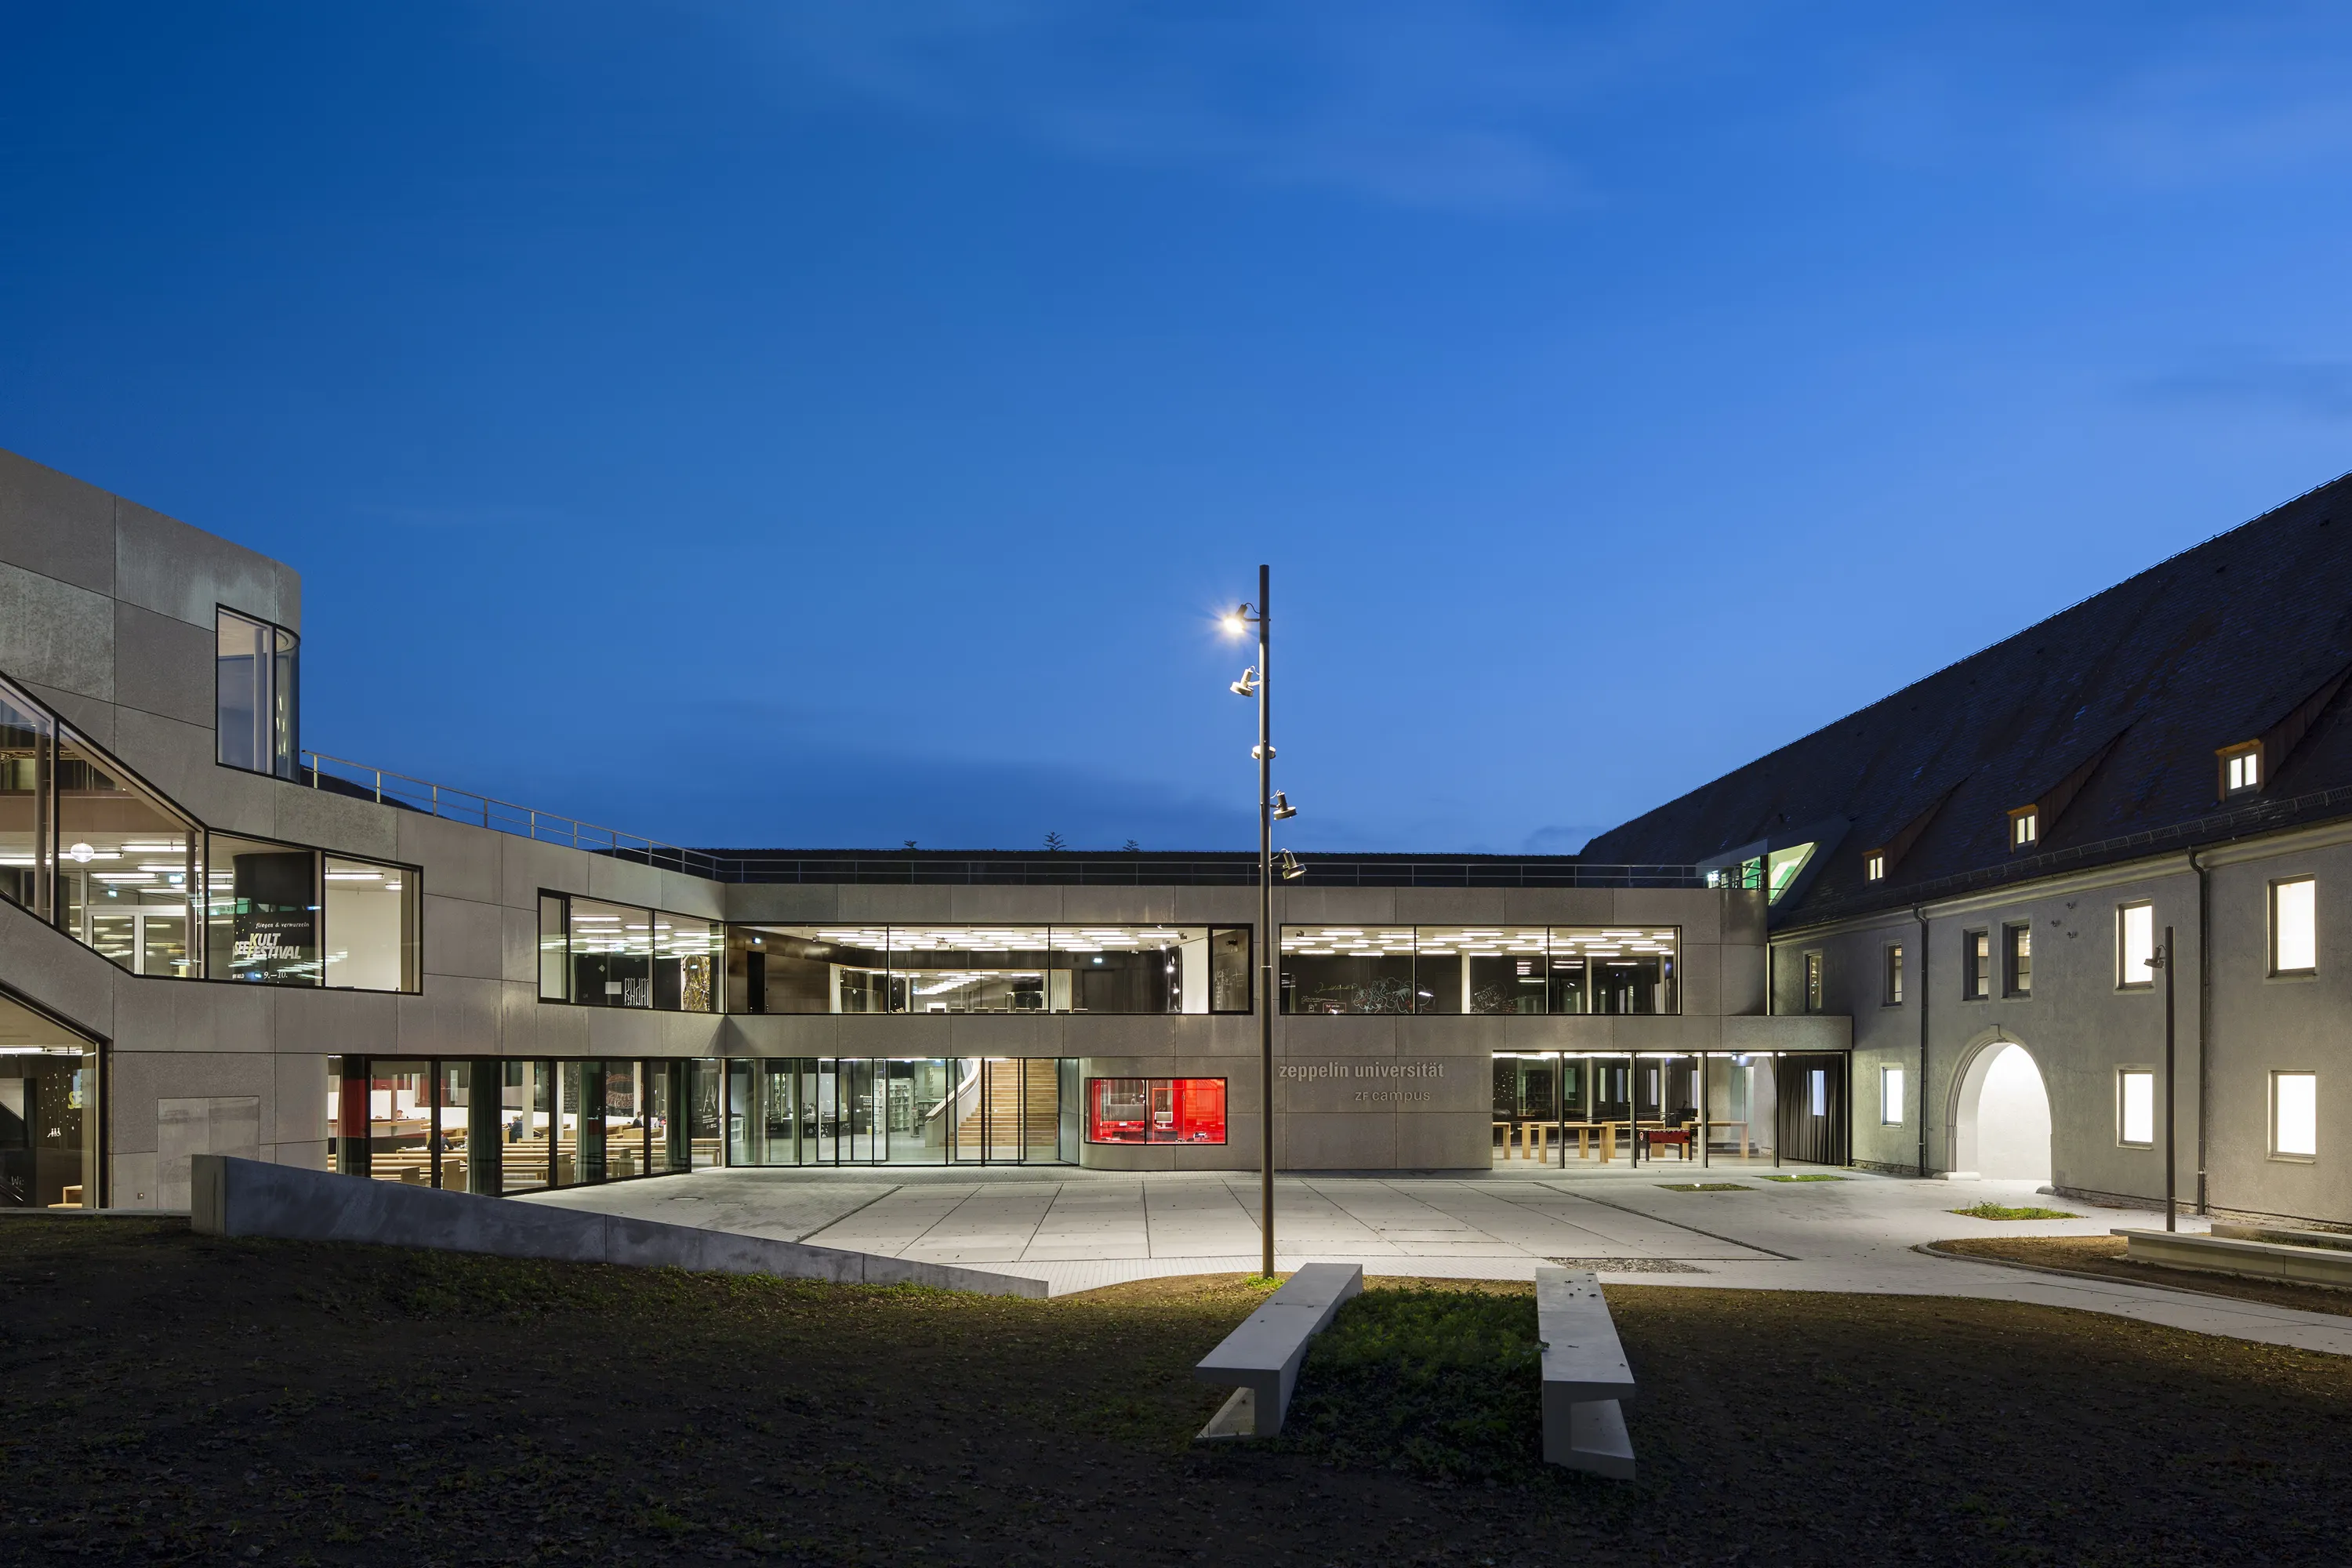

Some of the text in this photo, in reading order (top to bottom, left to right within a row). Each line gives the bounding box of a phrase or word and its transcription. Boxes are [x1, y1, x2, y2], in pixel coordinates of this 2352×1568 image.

[249, 933, 281, 946] KULT
[234, 941, 250, 956] SEE
[246, 946, 301, 959] FESTIVAL
[1279, 1062, 1444, 1082] zeppelin universität
[1372, 1091, 1431, 1104] campus
